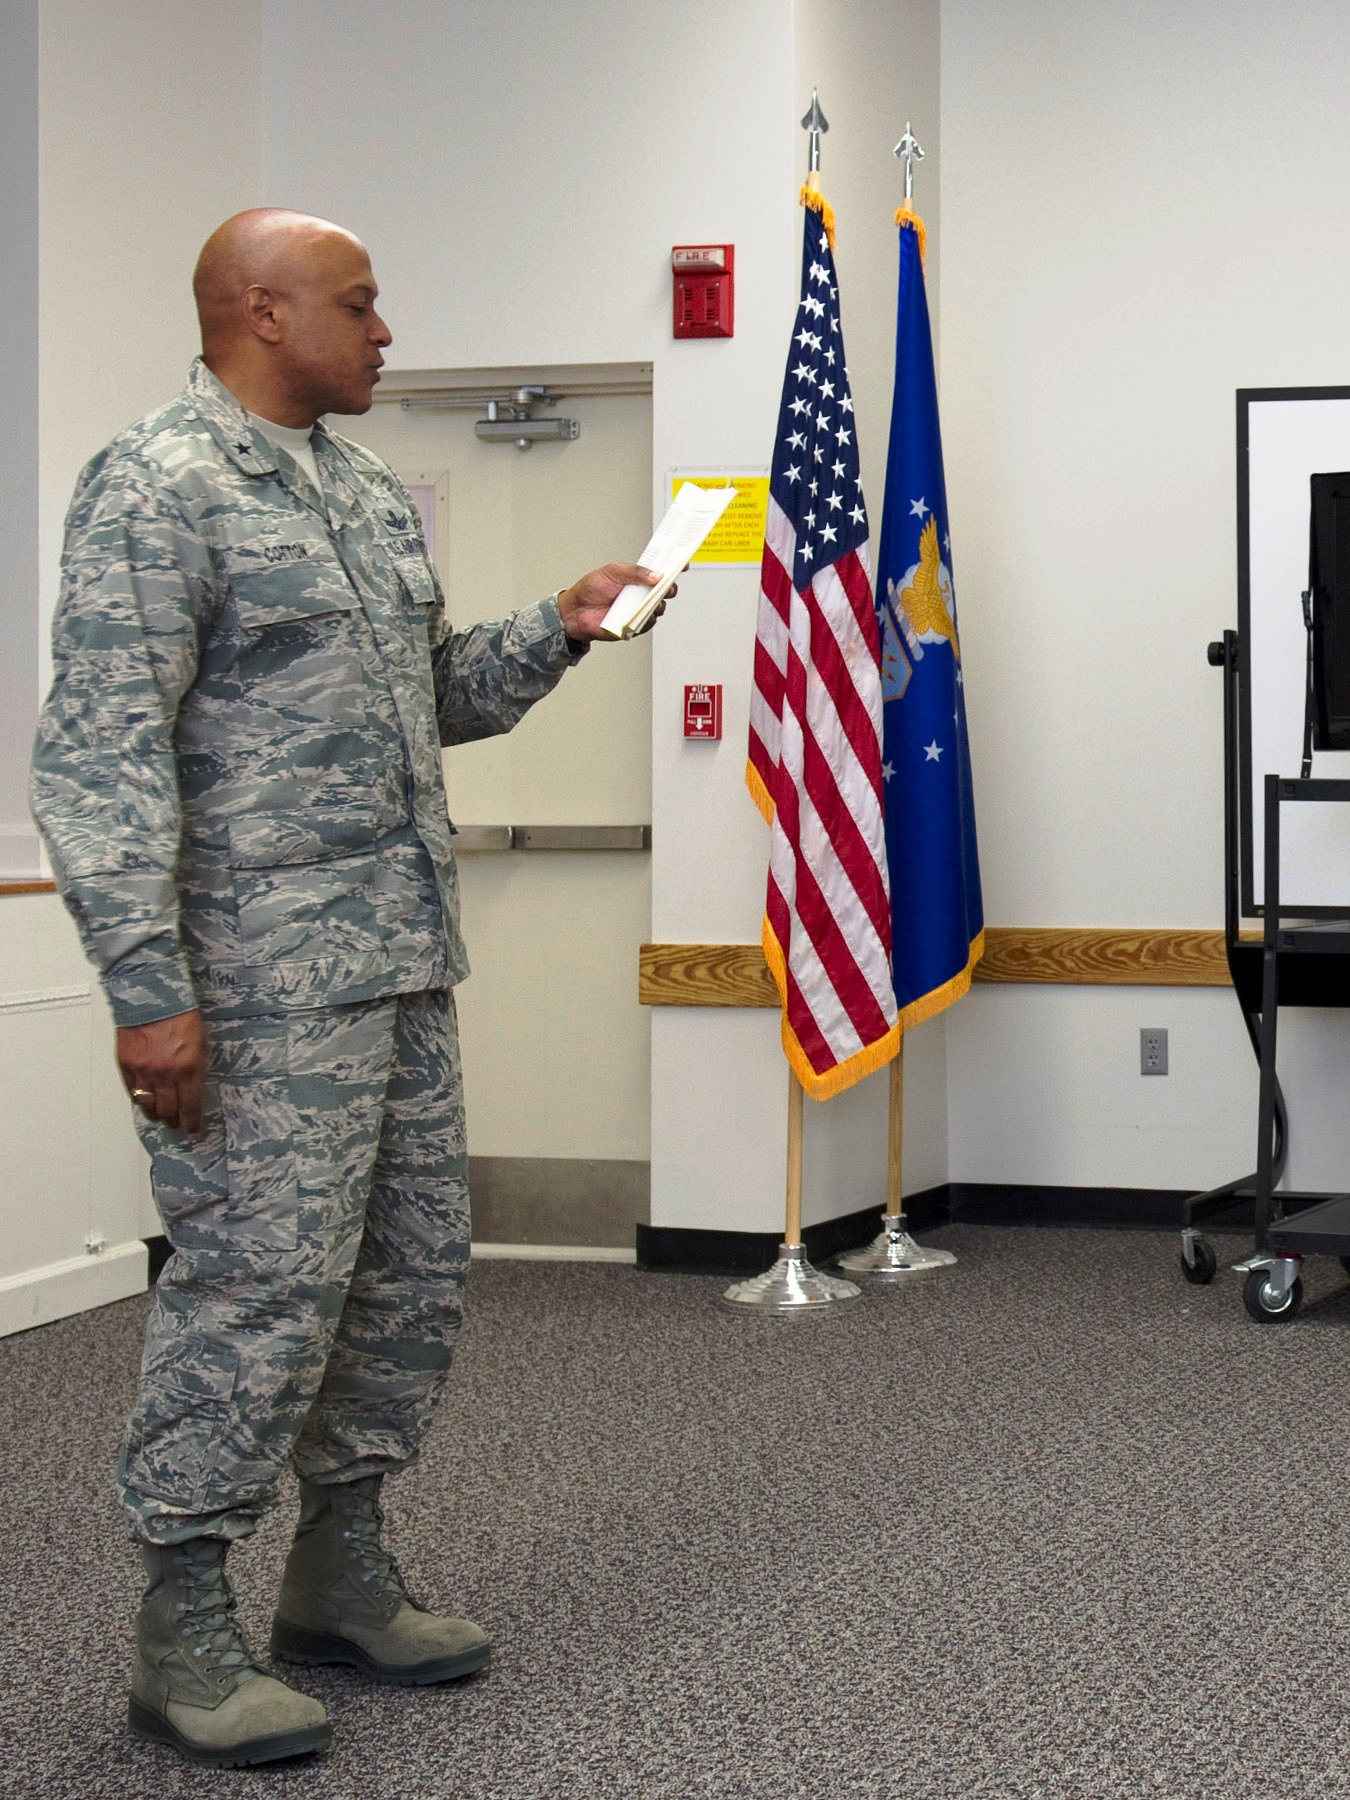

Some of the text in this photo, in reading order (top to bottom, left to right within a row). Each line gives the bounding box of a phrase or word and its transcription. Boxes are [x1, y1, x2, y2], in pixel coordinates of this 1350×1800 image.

[676, 252, 709, 260] FIRE
[264, 543, 308, 563] COTTON
[689, 692, 711, 700] FIRE
